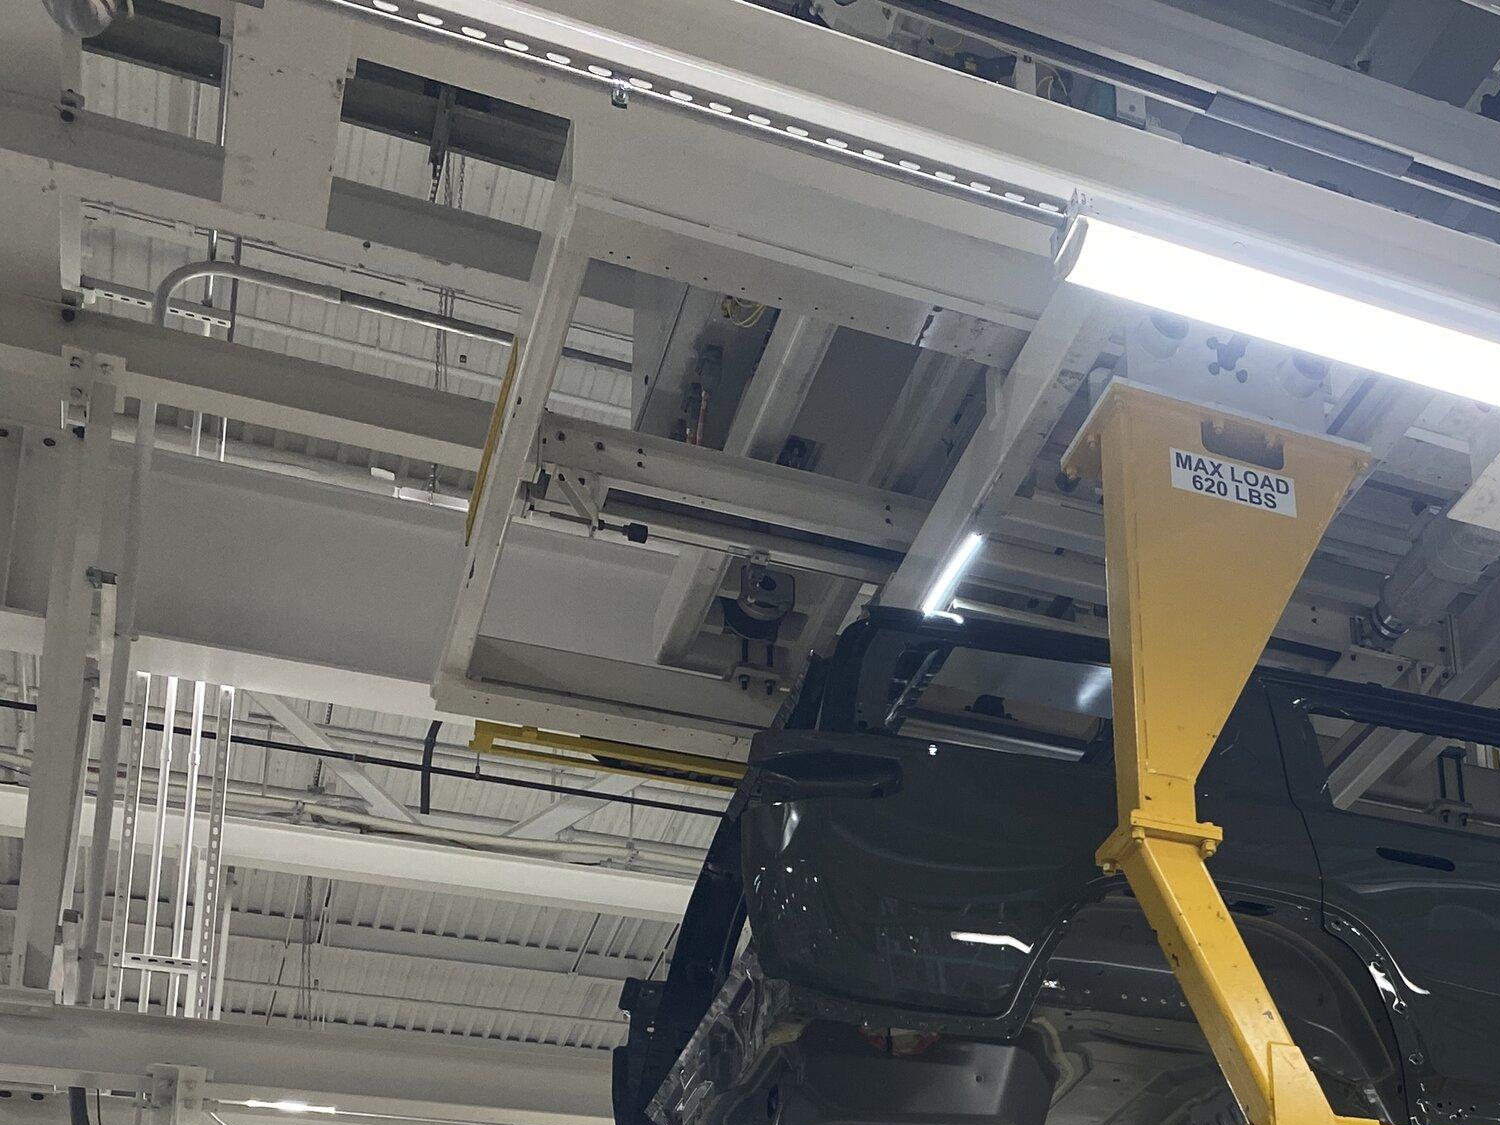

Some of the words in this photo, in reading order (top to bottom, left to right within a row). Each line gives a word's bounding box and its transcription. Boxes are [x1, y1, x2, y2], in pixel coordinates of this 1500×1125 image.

[1175, 452, 1224, 479] MAX
[1230, 466, 1290, 496] LOAD
[1192, 475, 1228, 497] 620
[1235, 485, 1277, 509] LBS
